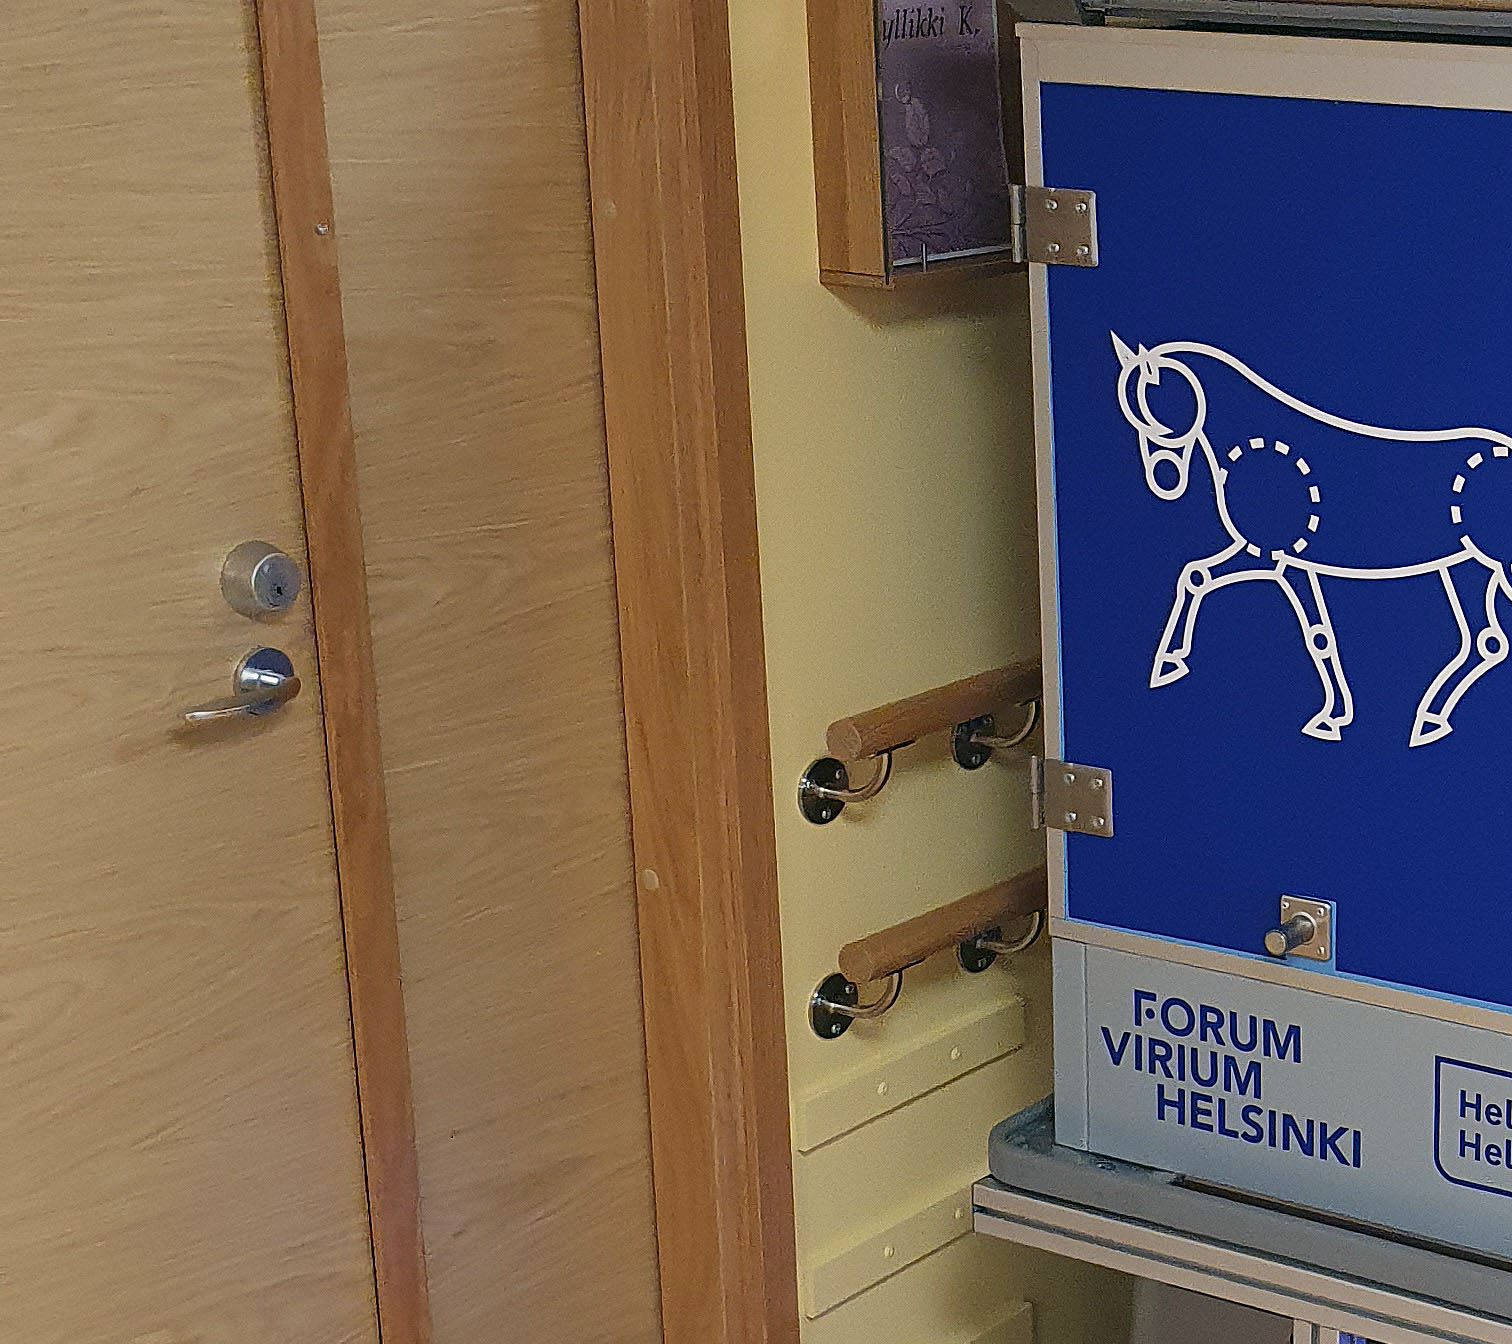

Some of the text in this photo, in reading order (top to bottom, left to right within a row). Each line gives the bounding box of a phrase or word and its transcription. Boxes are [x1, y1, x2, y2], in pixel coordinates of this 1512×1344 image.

[881, 6, 945, 50] yllikki
[1100, 1025, 1262, 1099] VIRIUM
[1133, 988, 1302, 1063] FORUM
[1157, 1083, 1362, 1169] HELSINKI
